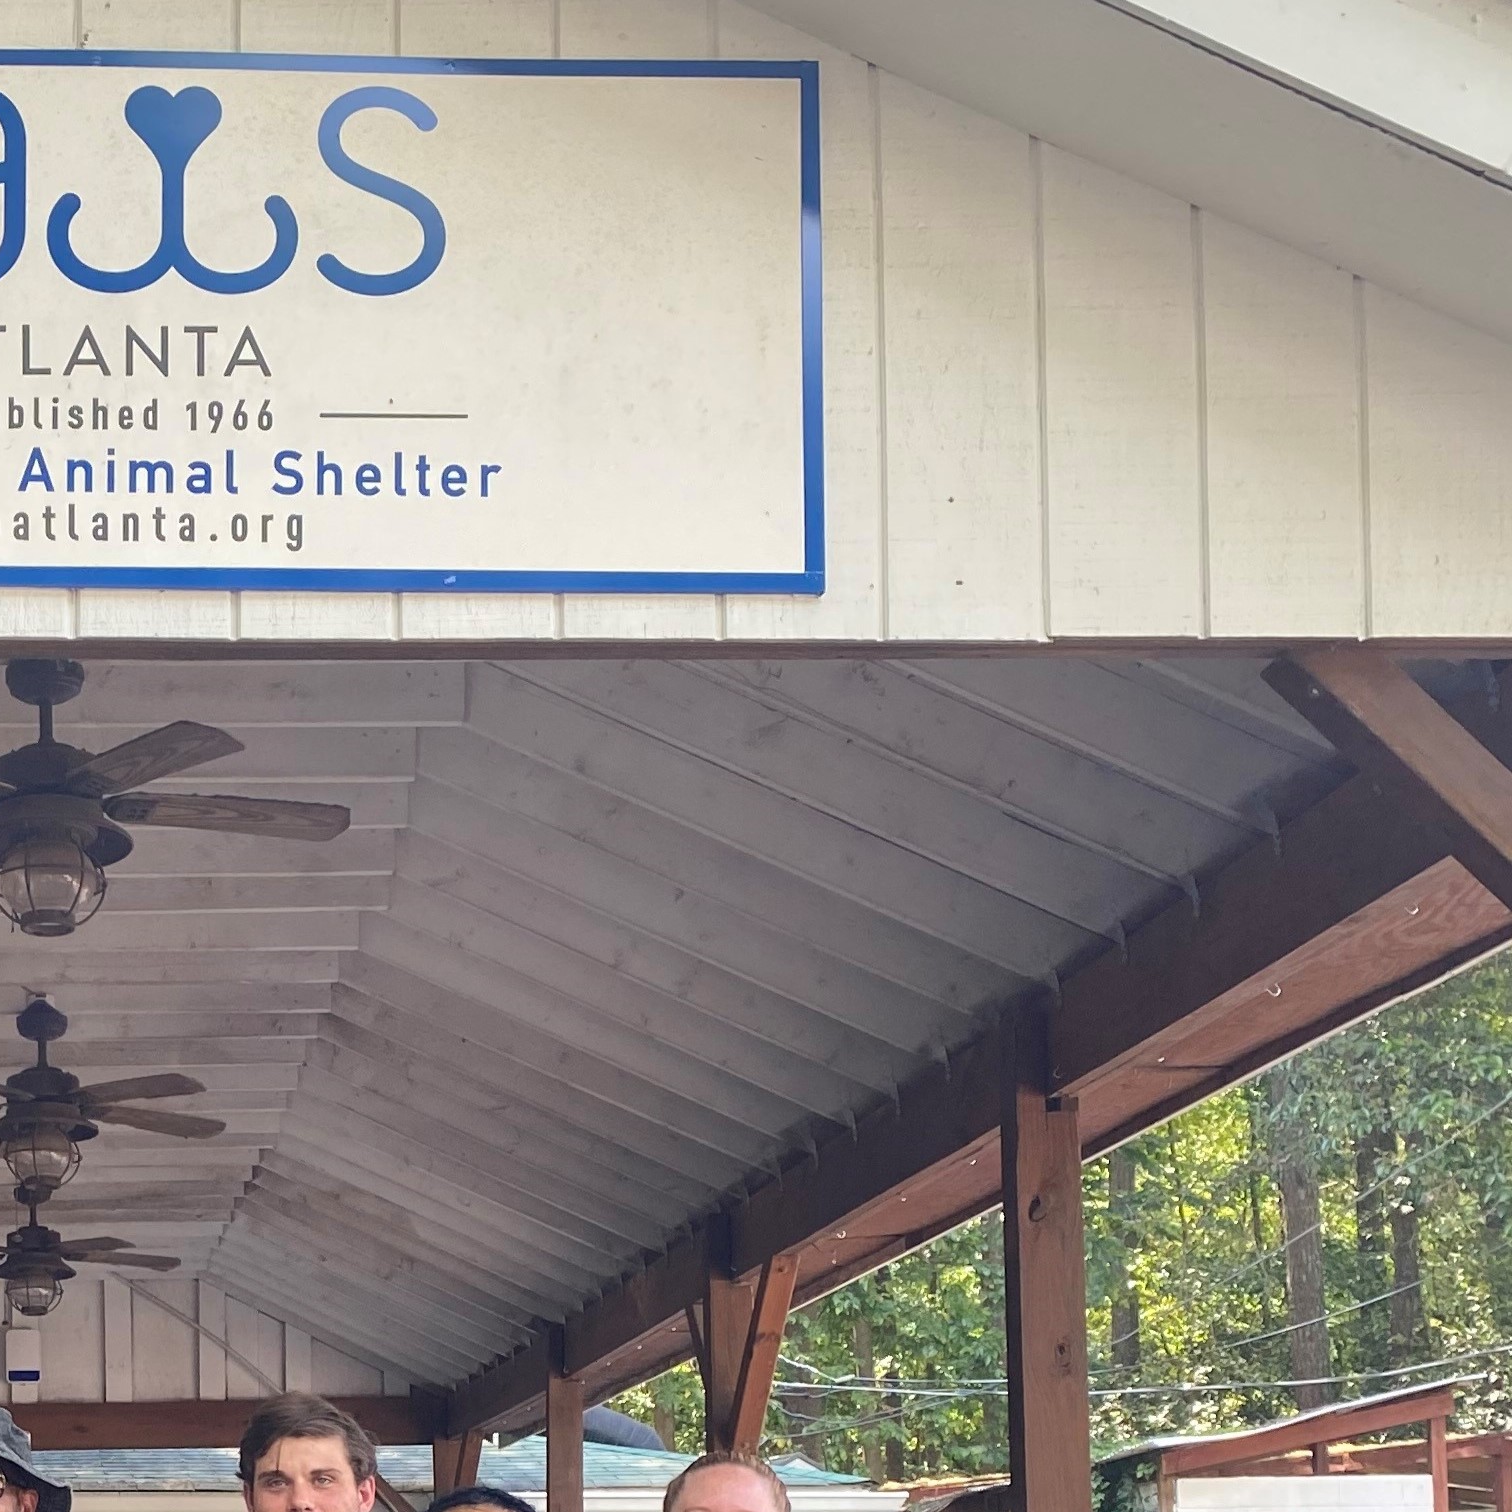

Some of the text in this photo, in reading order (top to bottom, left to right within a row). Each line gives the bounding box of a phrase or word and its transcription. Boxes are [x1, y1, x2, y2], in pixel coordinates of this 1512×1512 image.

[185, 399, 274, 434] 1966
[18, 447, 239, 496] Animal
[272, 450, 502, 498] Shelter
